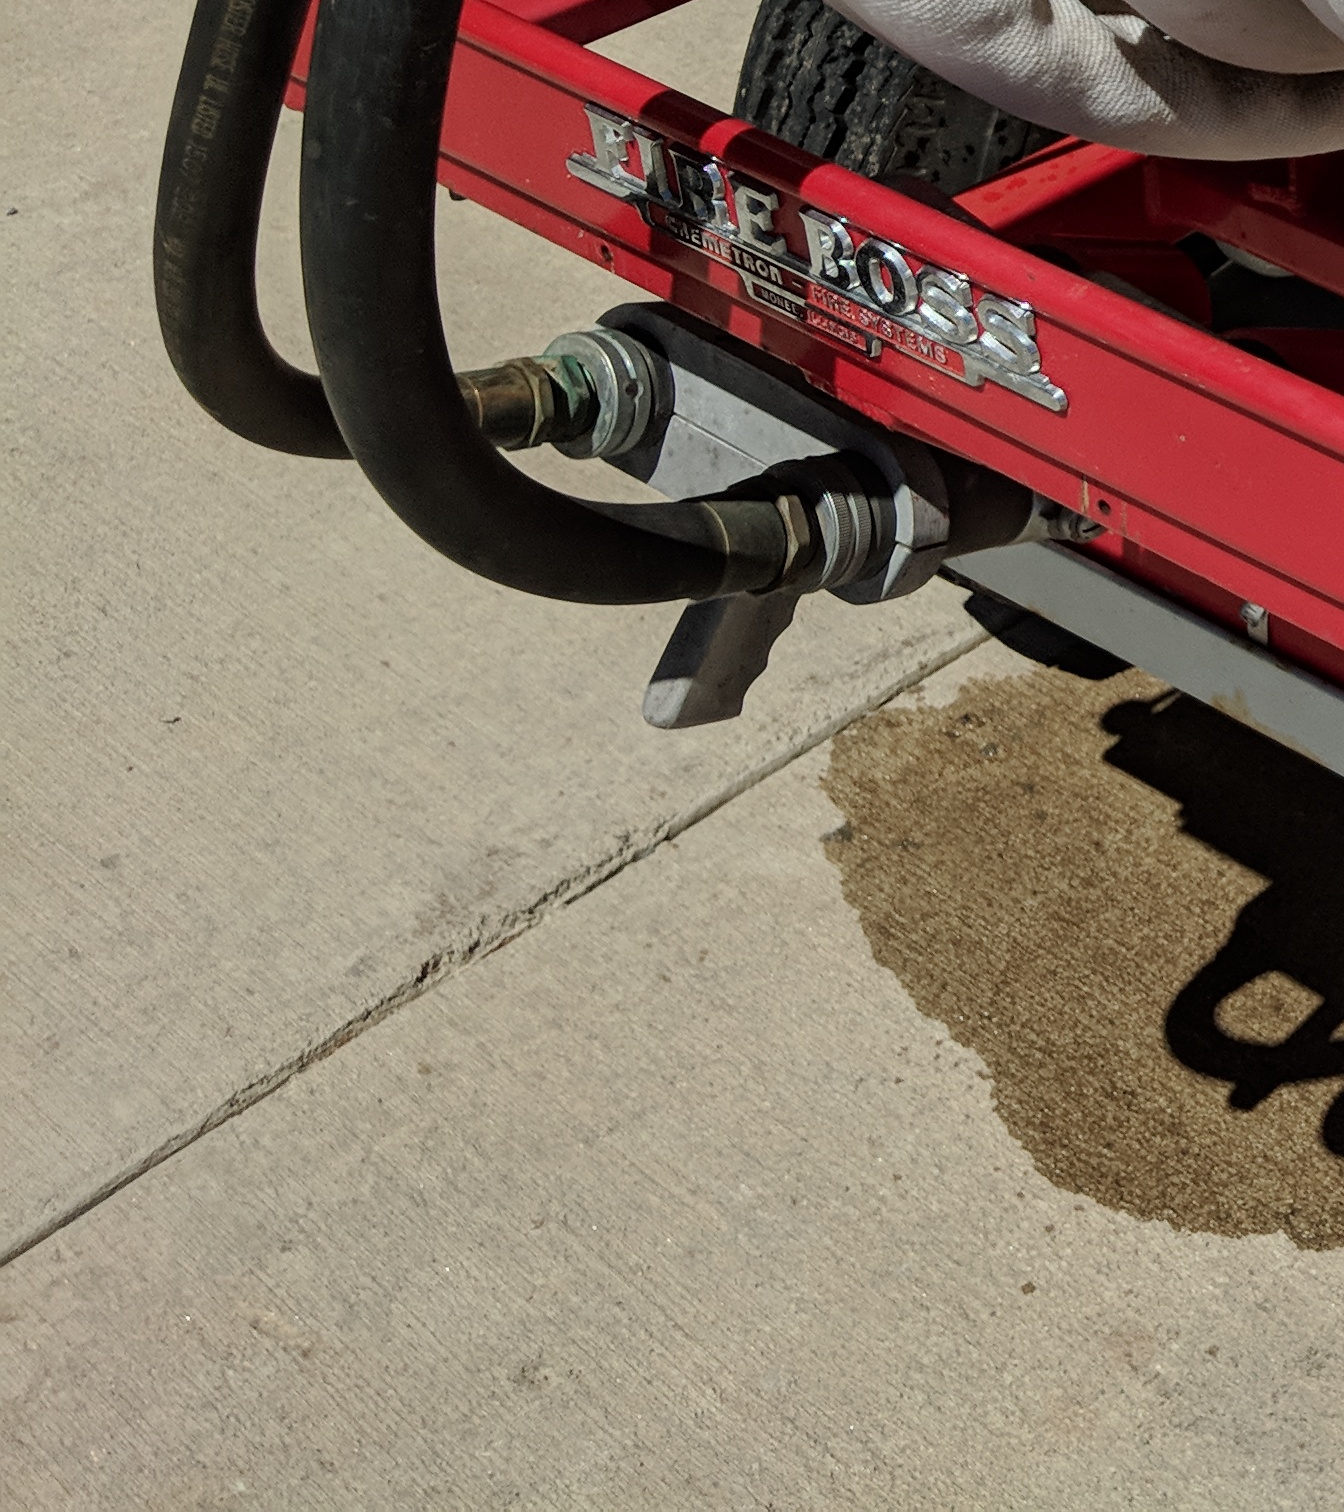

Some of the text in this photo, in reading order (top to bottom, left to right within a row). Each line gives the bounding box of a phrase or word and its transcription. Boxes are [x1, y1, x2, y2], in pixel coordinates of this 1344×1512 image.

[584, 102, 1042, 375] FIRE BOSS
[857, 306, 950, 365] SYSTEMS
